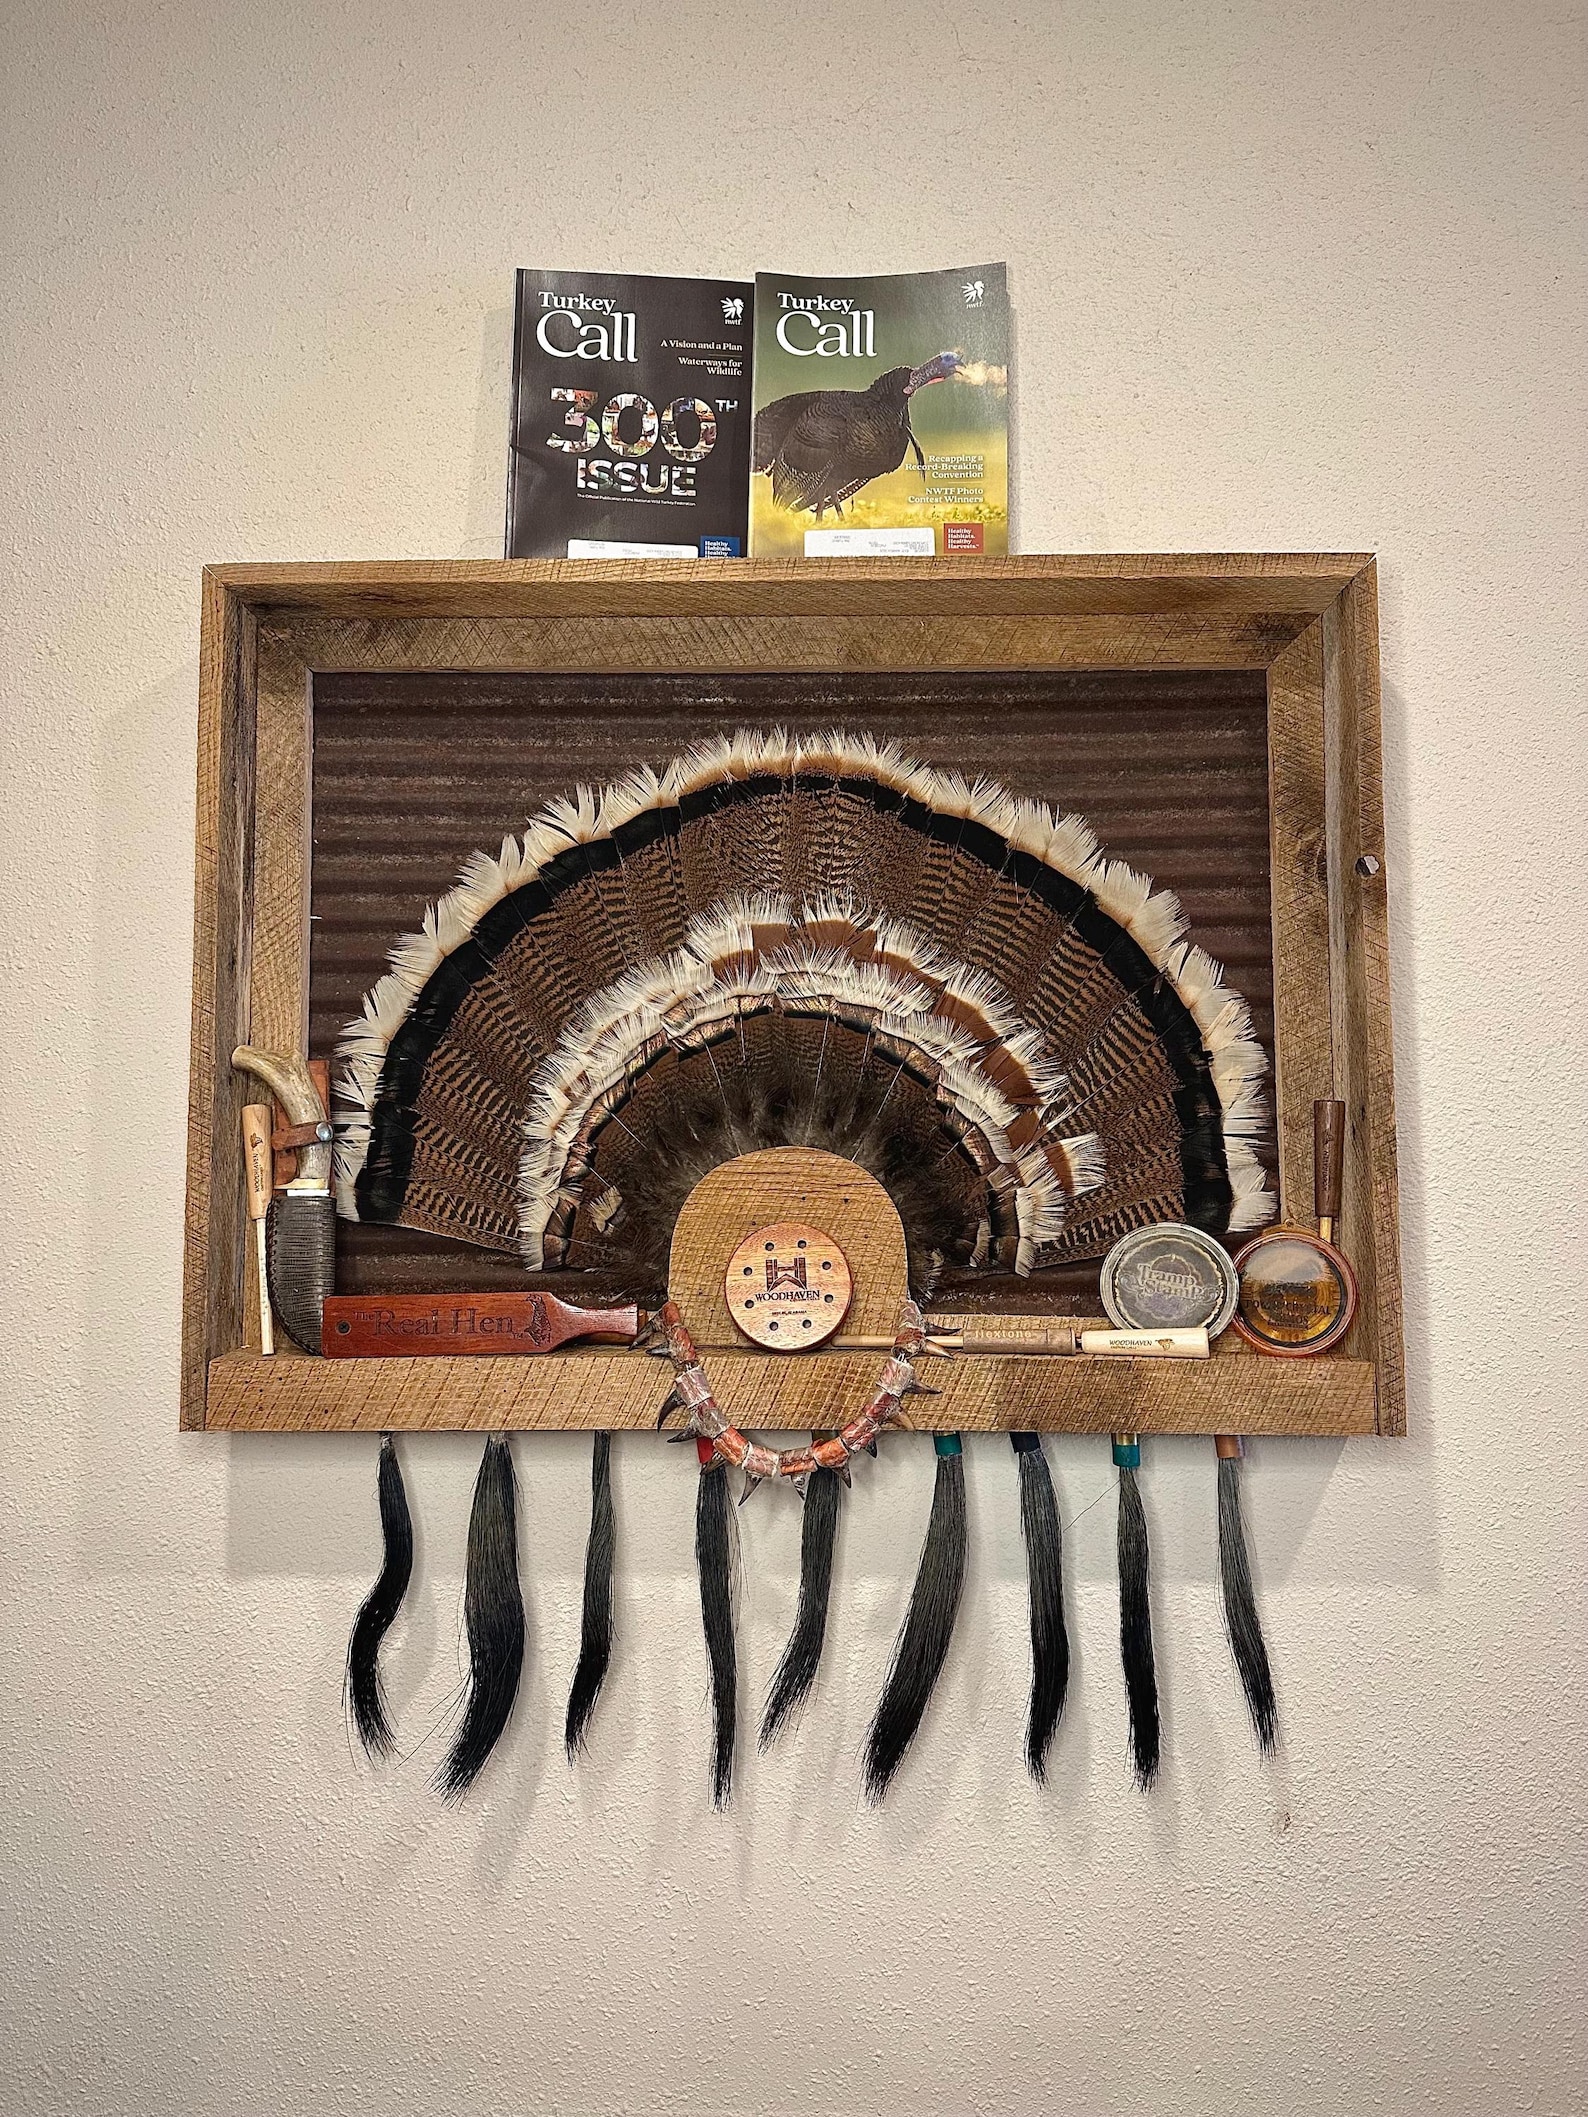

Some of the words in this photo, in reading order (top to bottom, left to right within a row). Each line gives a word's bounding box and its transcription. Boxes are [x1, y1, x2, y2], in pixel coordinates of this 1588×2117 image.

[538, 291, 616, 315] Turkey
[777, 292, 854, 315] Turkey
[536, 309, 638, 363] Call
[776, 310, 877, 358] Call
[660, 339, 668, 347] A
[669, 340, 697, 349] Vision
[698, 342, 714, 350] and
[723, 343, 742, 352] Plan
[678, 356, 727, 368] Waterways
[729, 359, 742, 368] for
[707, 367, 742, 377] Wildlife
[929, 455, 976, 464] Recapping
[905, 463, 983, 471] Record-Breaking
[576, 458, 697, 497] ISSUE
[932, 471, 983, 479] Convention
[957, 487, 983, 495] Photo
[705, 541, 728, 549] Healthy
[1137, 1263, 1197, 1288] Tramp
[755, 1289, 820, 1302] WOODHAVEN
[353, 1311, 374, 1321] The
[373, 1308, 440, 1336] Real
[449, 1307, 514, 1335] Hen
[975, 1329, 1032, 1339] flextone
